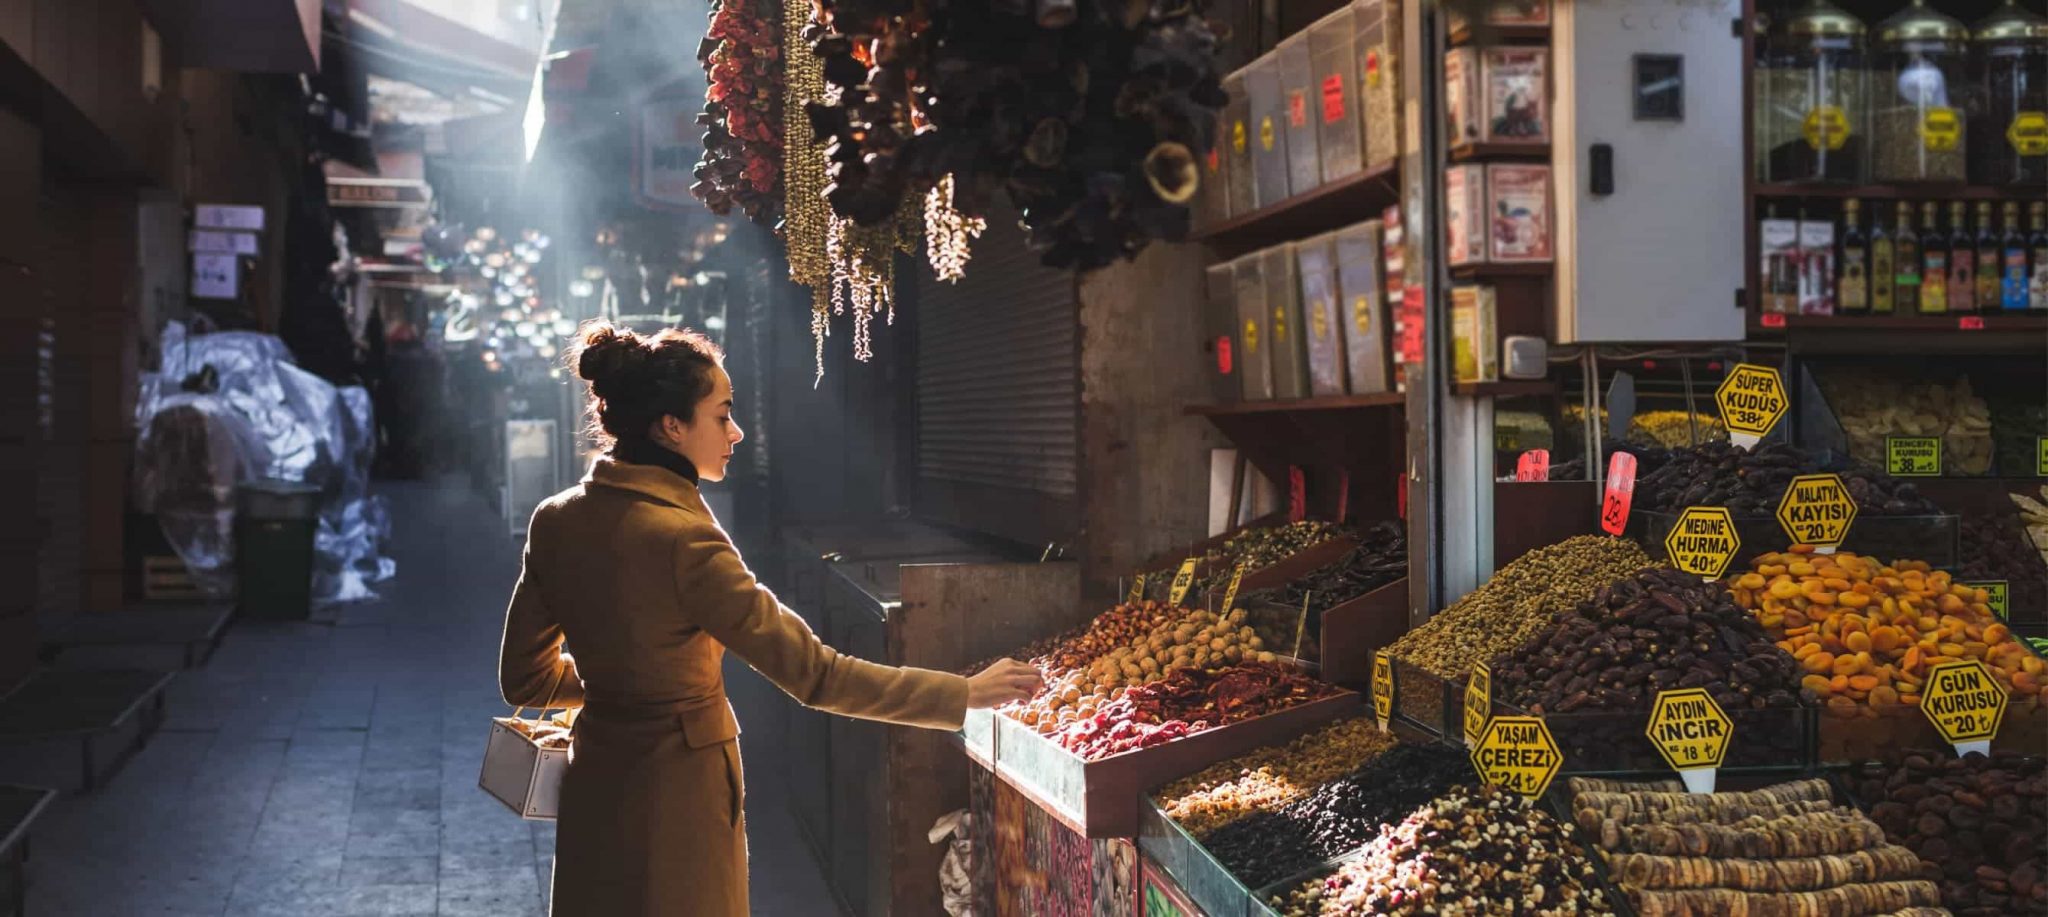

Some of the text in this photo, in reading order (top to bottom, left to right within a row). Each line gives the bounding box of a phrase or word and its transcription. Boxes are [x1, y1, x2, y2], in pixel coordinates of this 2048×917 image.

[1736, 371, 1773, 394] SÜPER
[1726, 391, 1778, 413] KUDÜS
[1796, 486, 1840, 504] MALATYA
[1790, 503, 1847, 523] KAYISI
[1676, 536, 1729, 554] HURMA
[1940, 670, 1981, 693] GÜN
[1666, 700, 1707, 721] AYDIN
[1931, 690, 1998, 715] KURUSU
[1496, 726, 1538, 749] YAŞAM
[1682, 745, 1698, 760] 18
